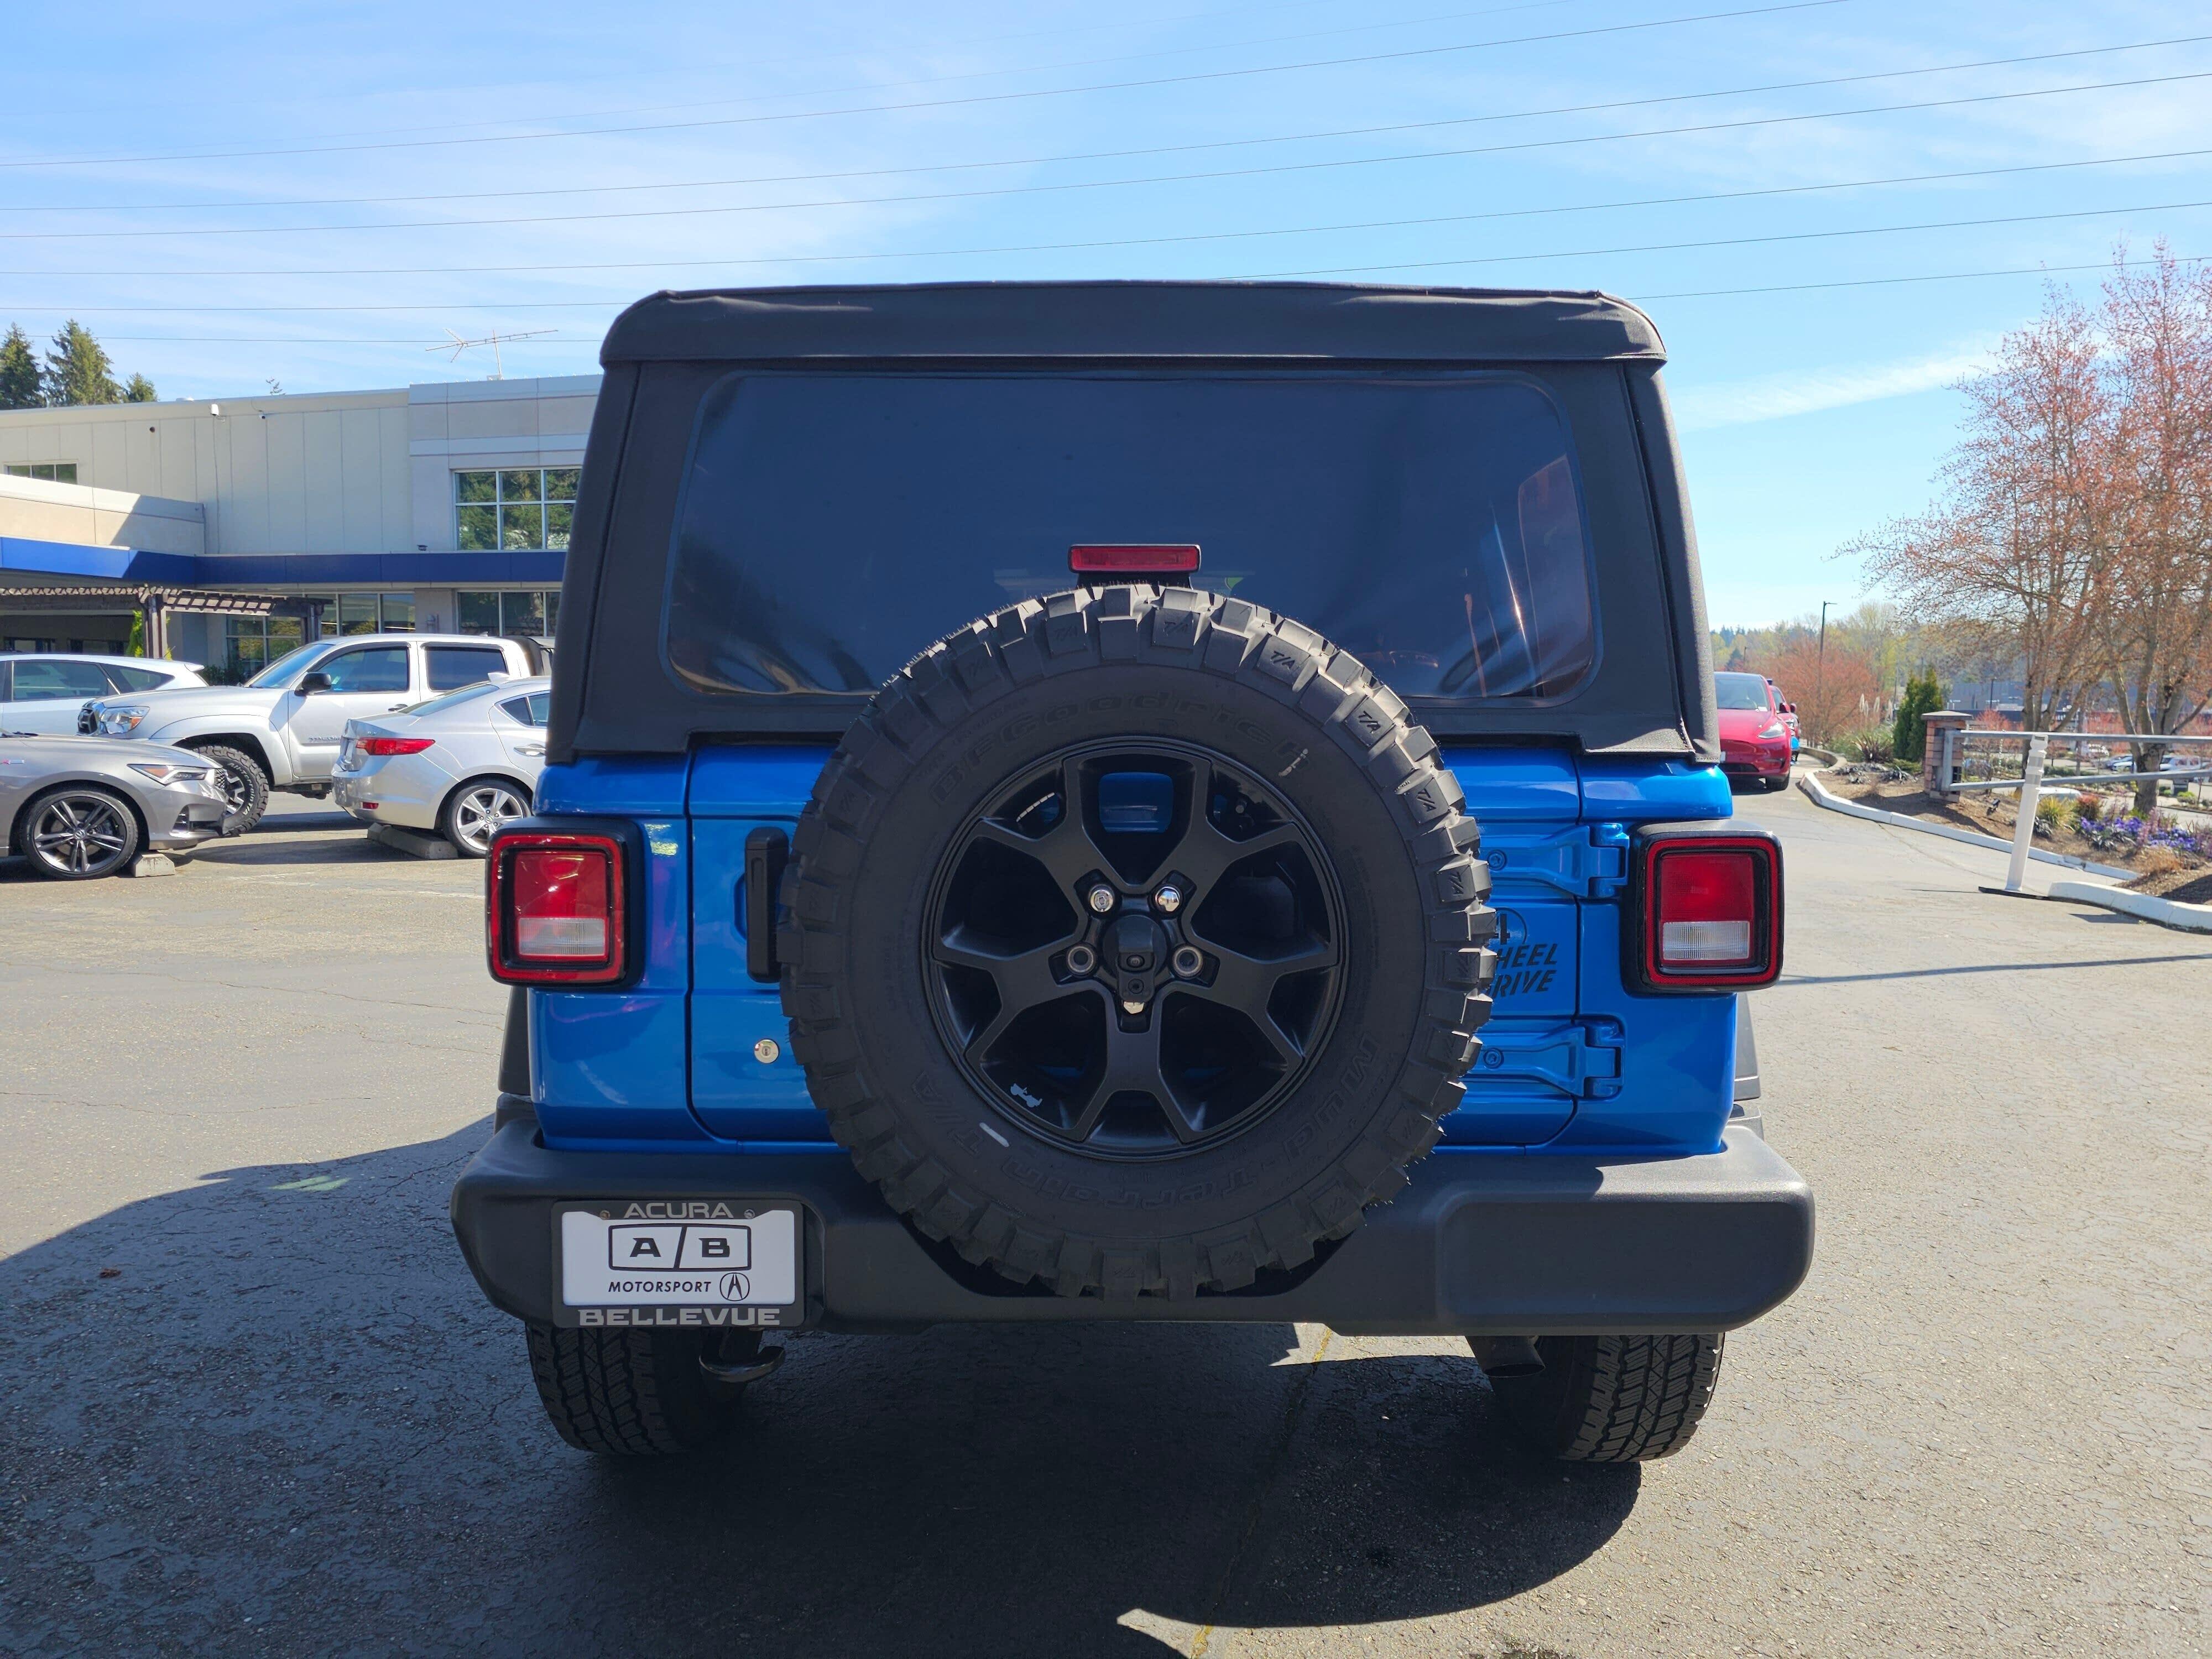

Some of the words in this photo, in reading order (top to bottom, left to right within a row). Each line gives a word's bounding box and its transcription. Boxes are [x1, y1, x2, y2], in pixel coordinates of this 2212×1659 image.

[1271, 651, 1295, 670] T/A
[1358, 711, 1381, 734] T/A
[928, 691, 1311, 807] BFGoodrich
[1417, 788, 1436, 812] T/A
[1449, 872, 1464, 895] T/A
[1492, 943, 1557, 969] HEEL
[1487, 969, 1557, 999] RIVE
[623, 1203, 734, 1219] ACURA
[608, 1281, 712, 1293] MOTORSPORT
[577, 1308, 780, 1326] BELLEVUE
